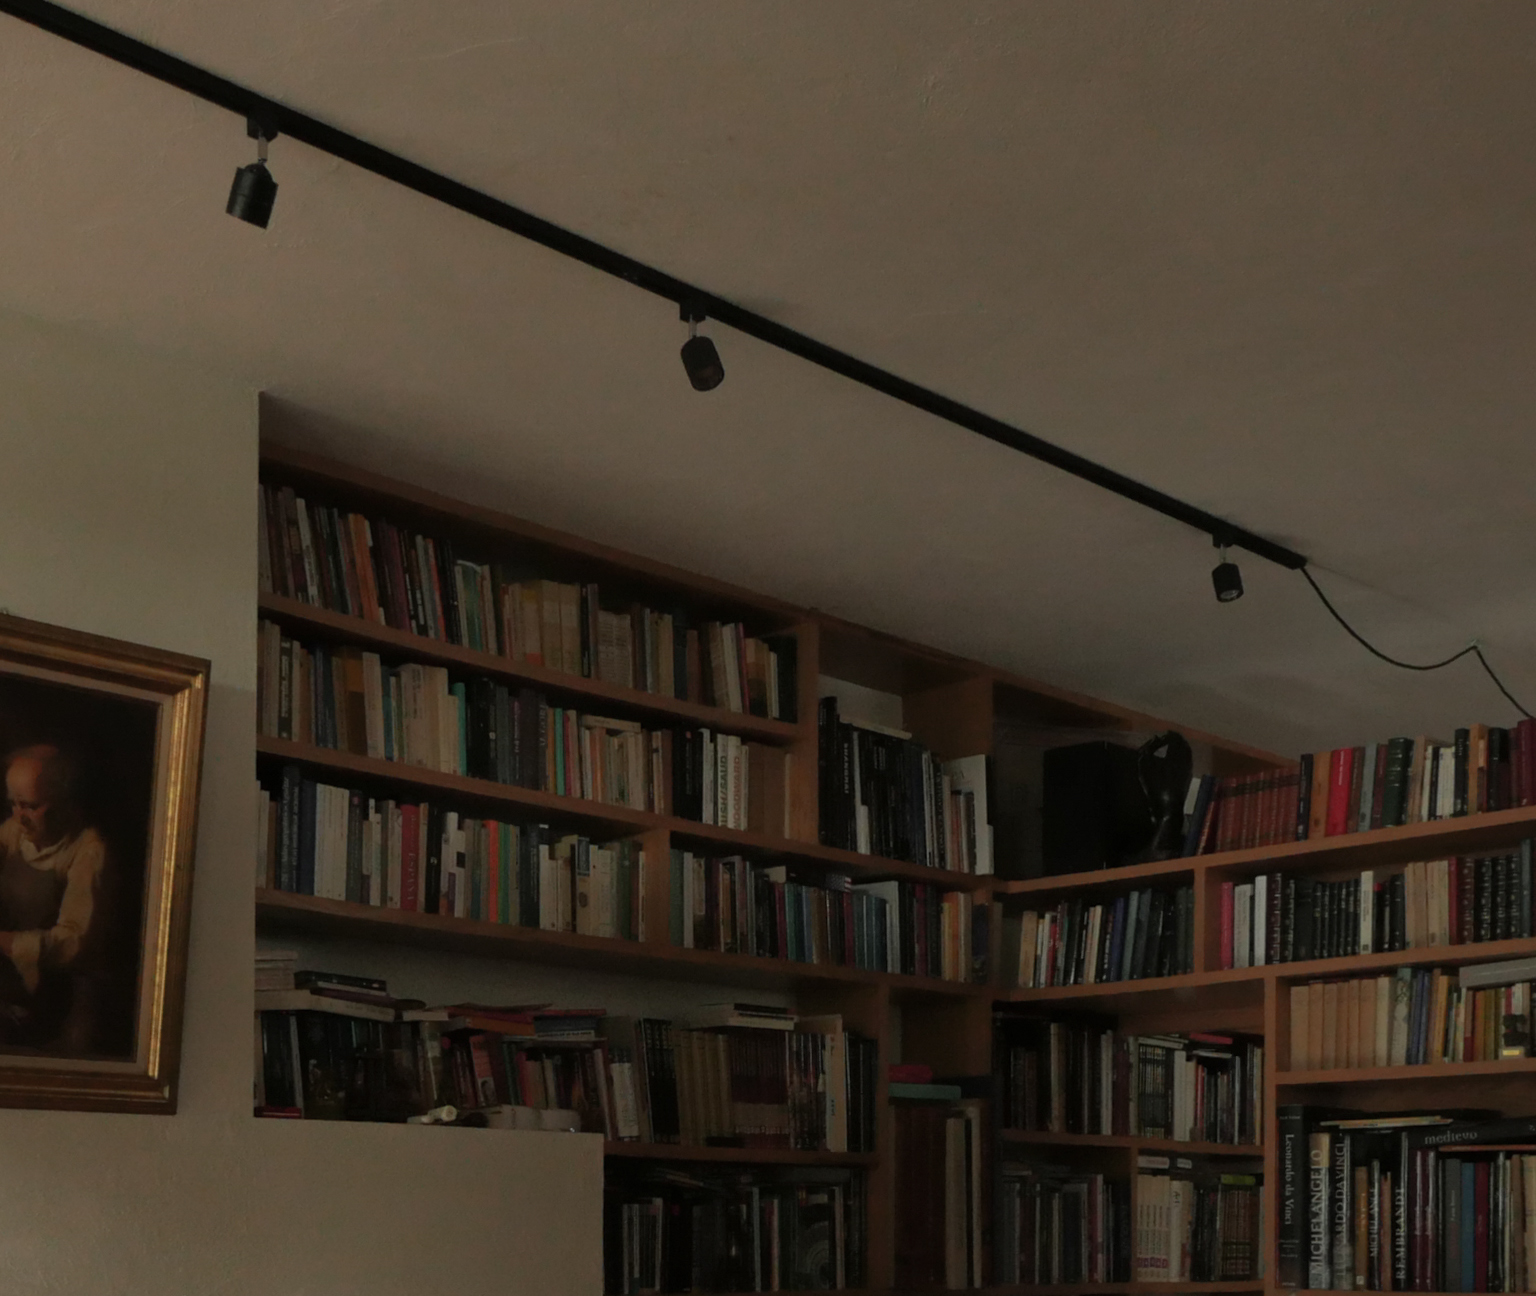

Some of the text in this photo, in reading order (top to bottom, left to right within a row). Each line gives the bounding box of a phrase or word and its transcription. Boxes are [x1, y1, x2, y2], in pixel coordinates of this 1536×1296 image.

[1284, 1134, 1295, 1225] Leonardo da Vinci
[1335, 1143, 1345, 1179] VINCI
[1424, 1131, 1477, 1144] medievo
[1310, 1150, 1323, 1274] MICHELANGELO
[1395, 1186, 1405, 1279] REMBRANDT
